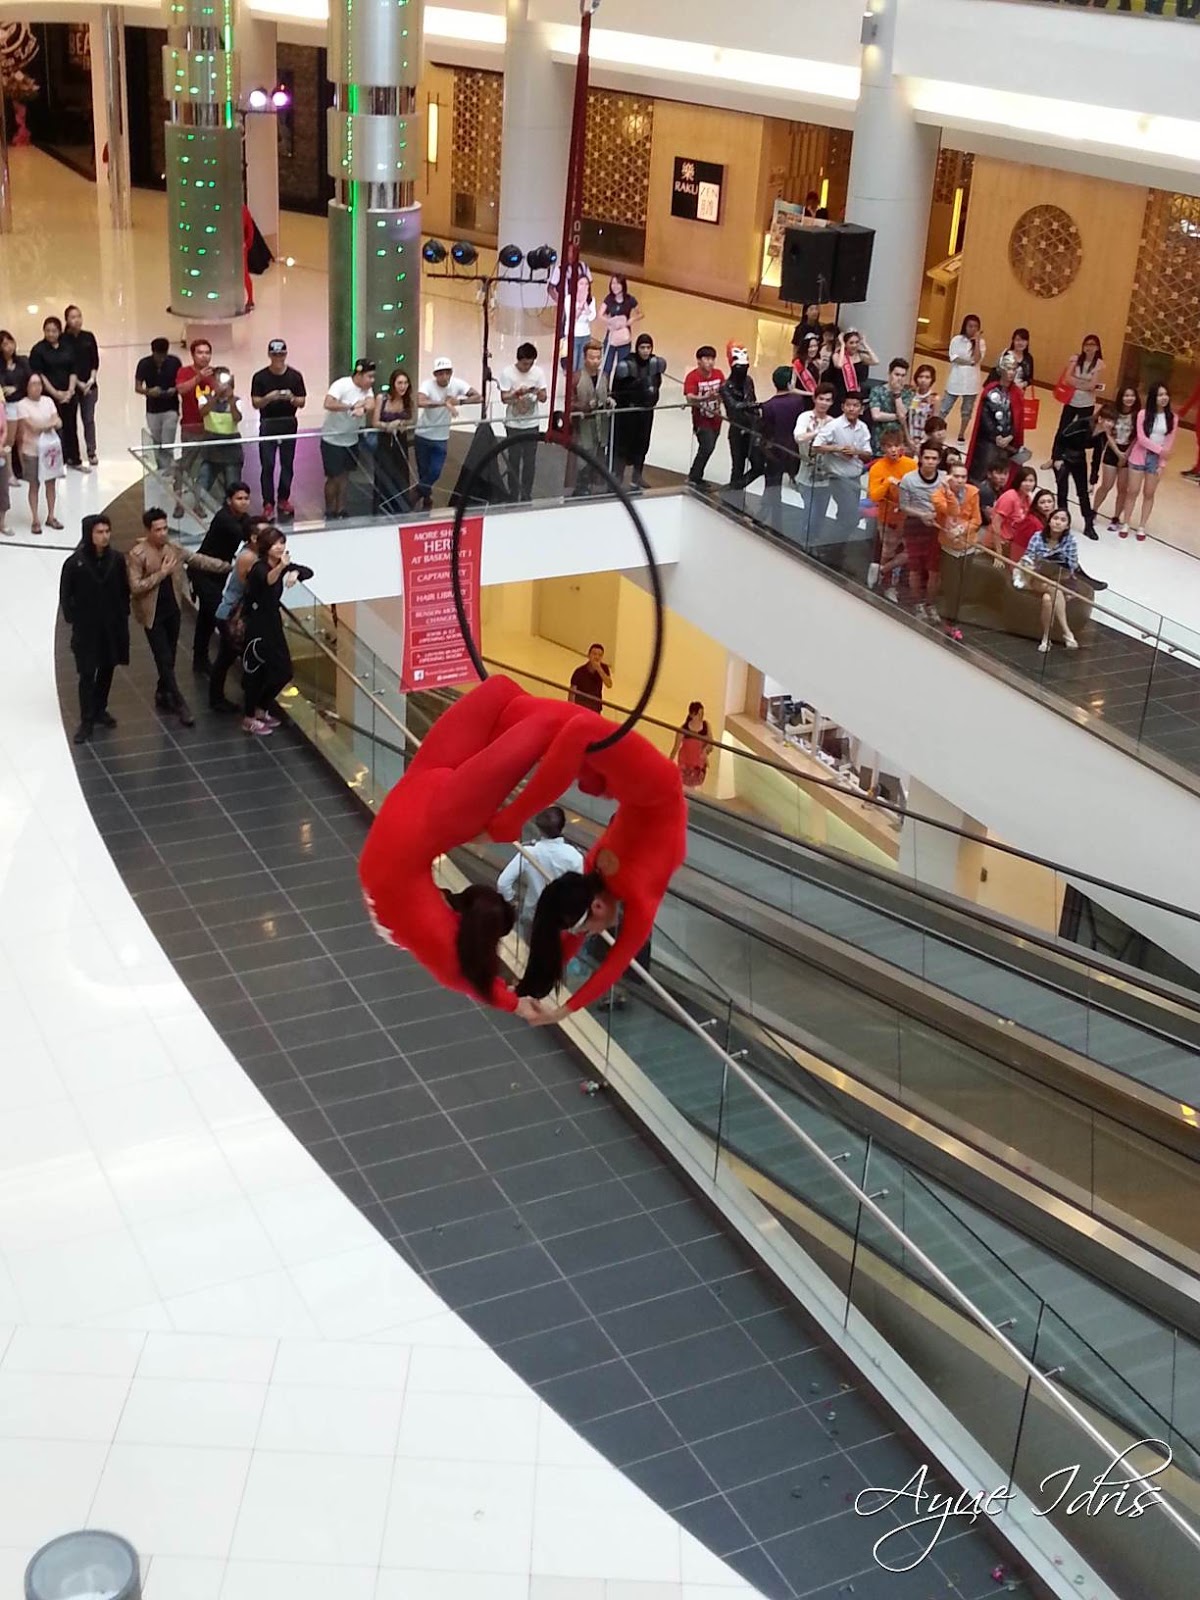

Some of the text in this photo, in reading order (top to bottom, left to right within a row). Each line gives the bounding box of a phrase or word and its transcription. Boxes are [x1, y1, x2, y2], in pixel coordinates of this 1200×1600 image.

[675, 181, 698, 195] RAKU
[413, 527, 467, 541] MORE SHS
[411, 556, 422, 565] AT
[424, 550, 467, 563] BASEMT
[417, 572, 450, 582] CAPTAIN
[416, 589, 466, 602] HAIR LIBRY
